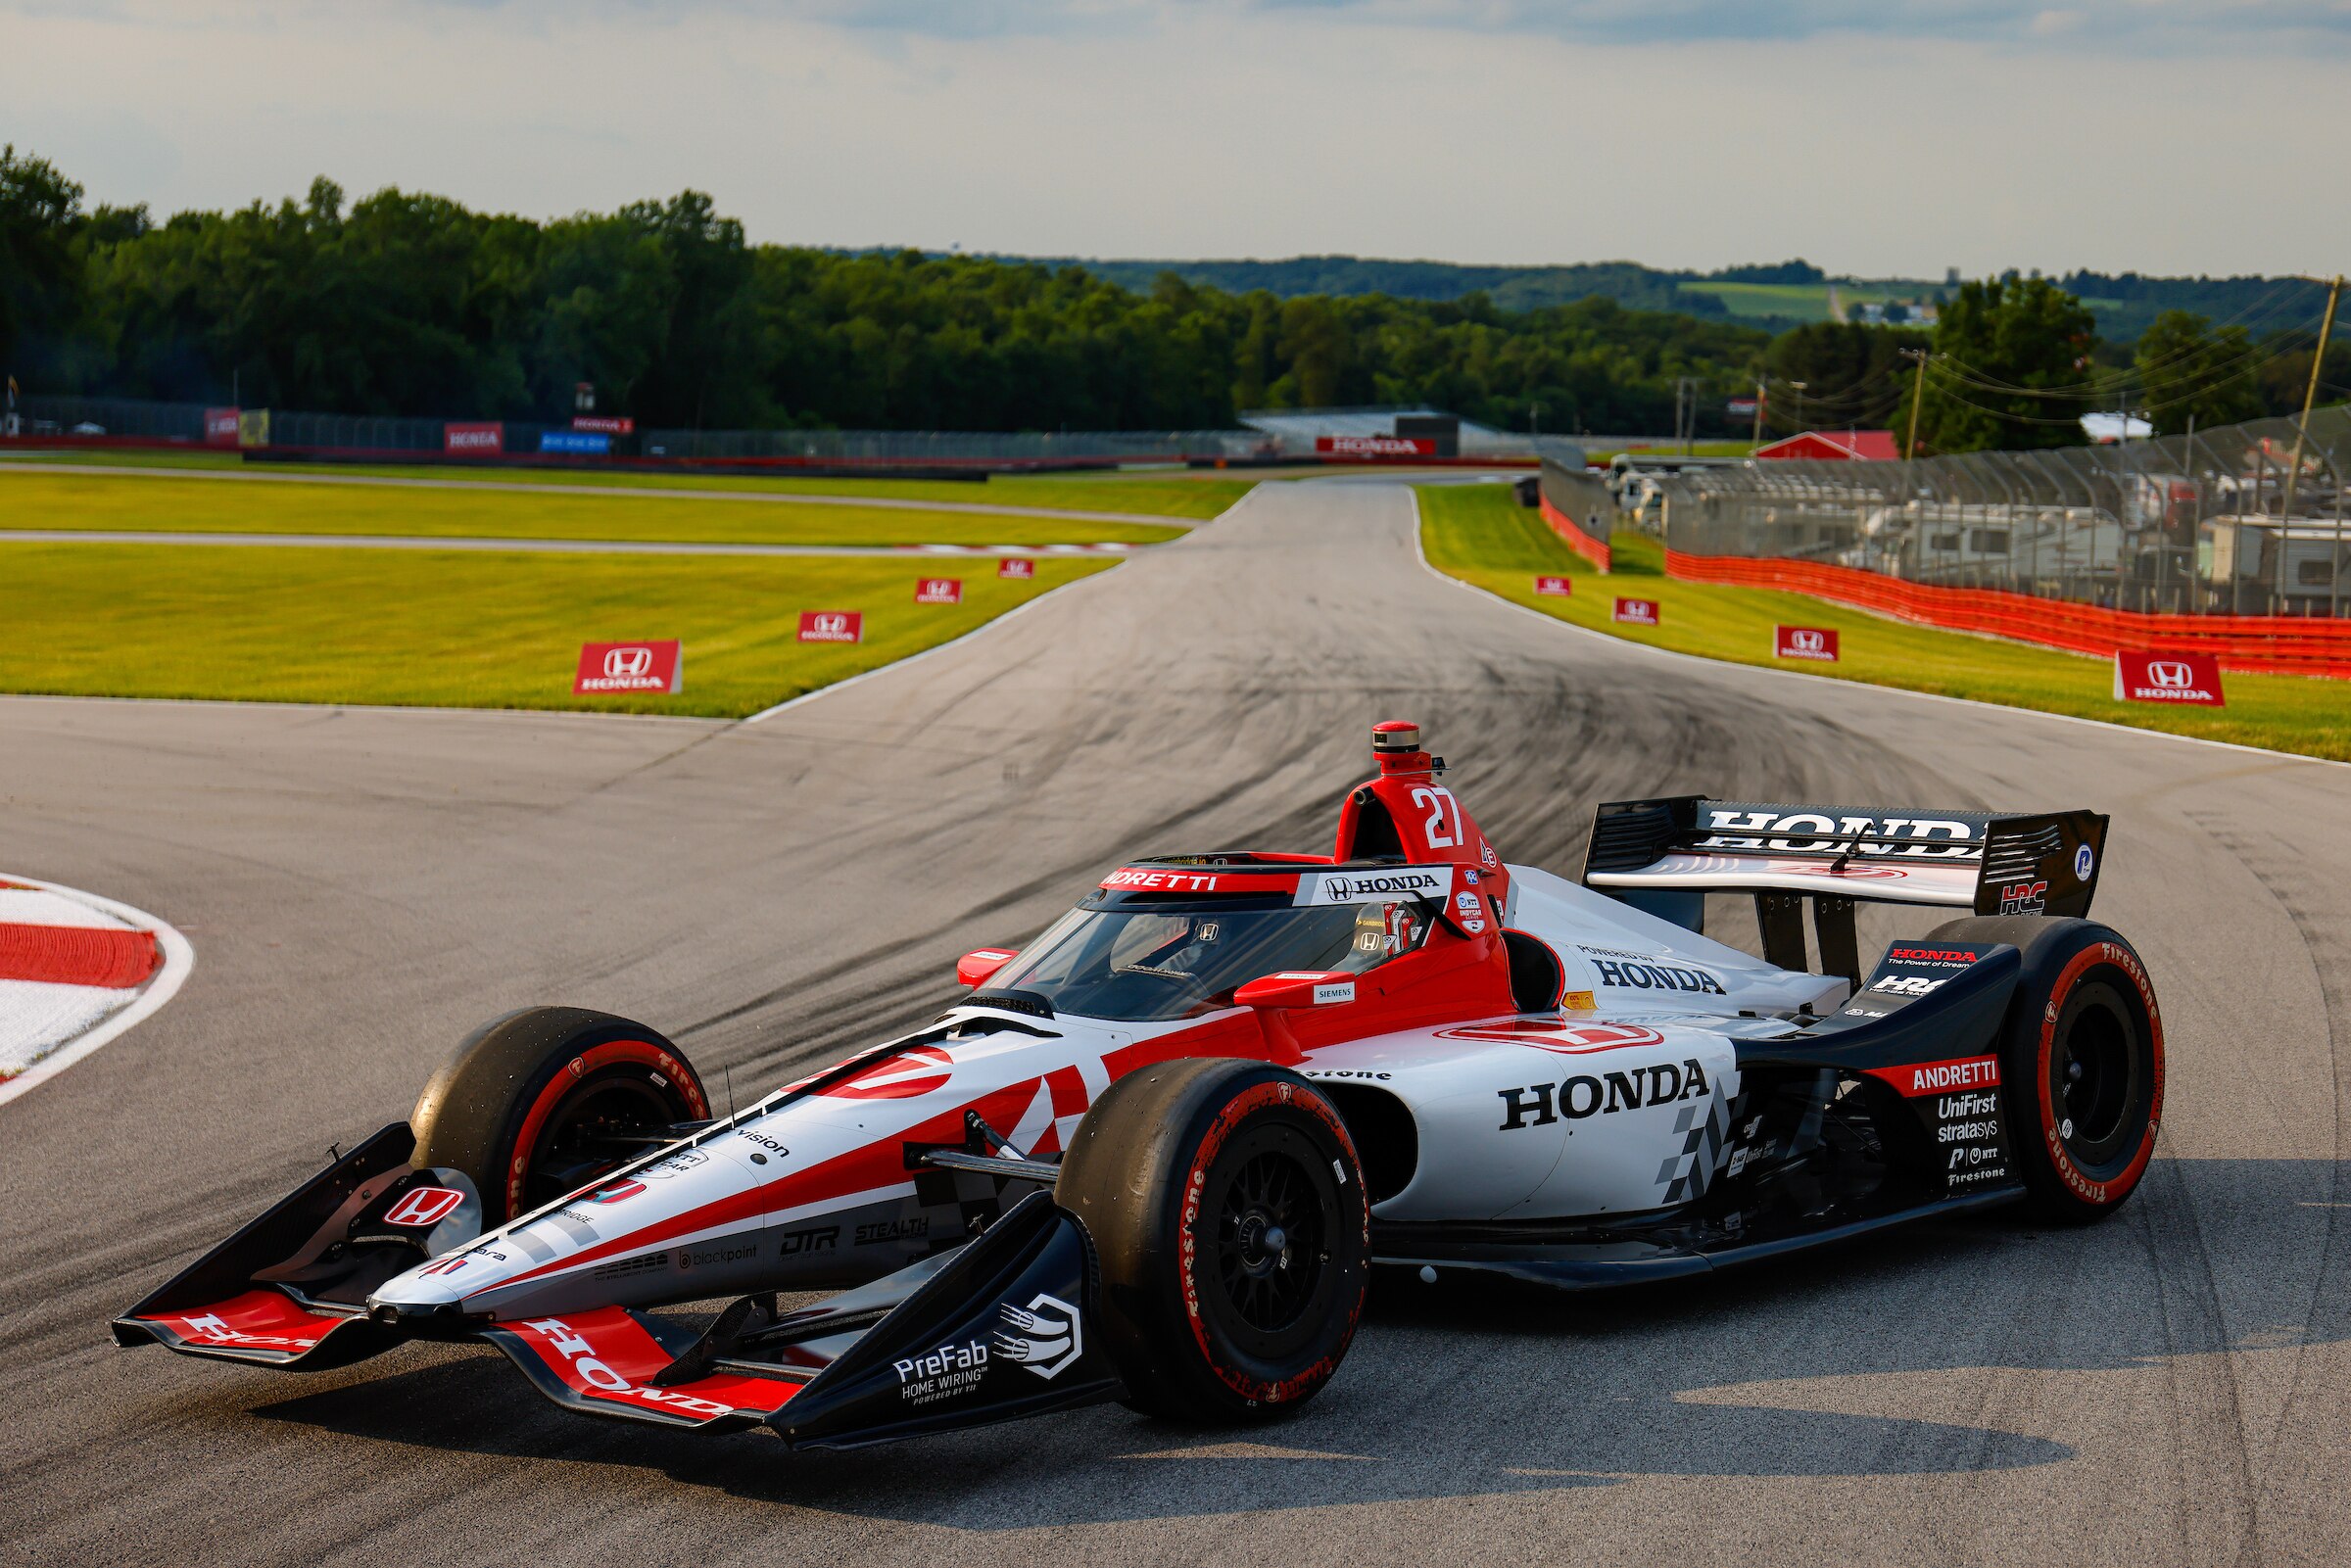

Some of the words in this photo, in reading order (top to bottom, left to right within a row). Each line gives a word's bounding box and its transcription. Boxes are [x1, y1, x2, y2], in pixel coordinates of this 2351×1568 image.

[1332, 438, 1418, 453] HONDA
[581, 677, 664, 690] HONDA
[2135, 688, 2214, 700] HONDA
[1412, 787, 1463, 849] 27
[1694, 811, 1989, 858] HOND
[1355, 875, 1440, 894] HONDA
[1576, 944, 1638, 960] POWERED
[1890, 948, 1979, 962] HONDA
[1590, 959, 1727, 996] HONDA
[2102, 942, 2157, 1020] Firestone
[1319, 988, 1351, 999] SIEMENS
[1913, 1061, 1996, 1090] ANDRETTI
[1498, 1058, 1710, 1131] HONDA
[1938, 1093, 1996, 1119] UniFirst
[1938, 1120, 1997, 1143] stratasys
[1982, 1147, 1998, 1160] NTT
[2049, 1127, 2106, 1203] Firestone
[1947, 1167, 2005, 1186] Firestone
[694, 1244, 757, 1266] blackpoint
[180, 1312, 320, 1348] HON
[521, 1317, 735, 1417] HOND
[892, 1340, 988, 1383] PreFab
[901, 1379, 935, 1400] HOME
[913, 1390, 951, 1405] POWERED
[952, 1387, 963, 1396] BY
